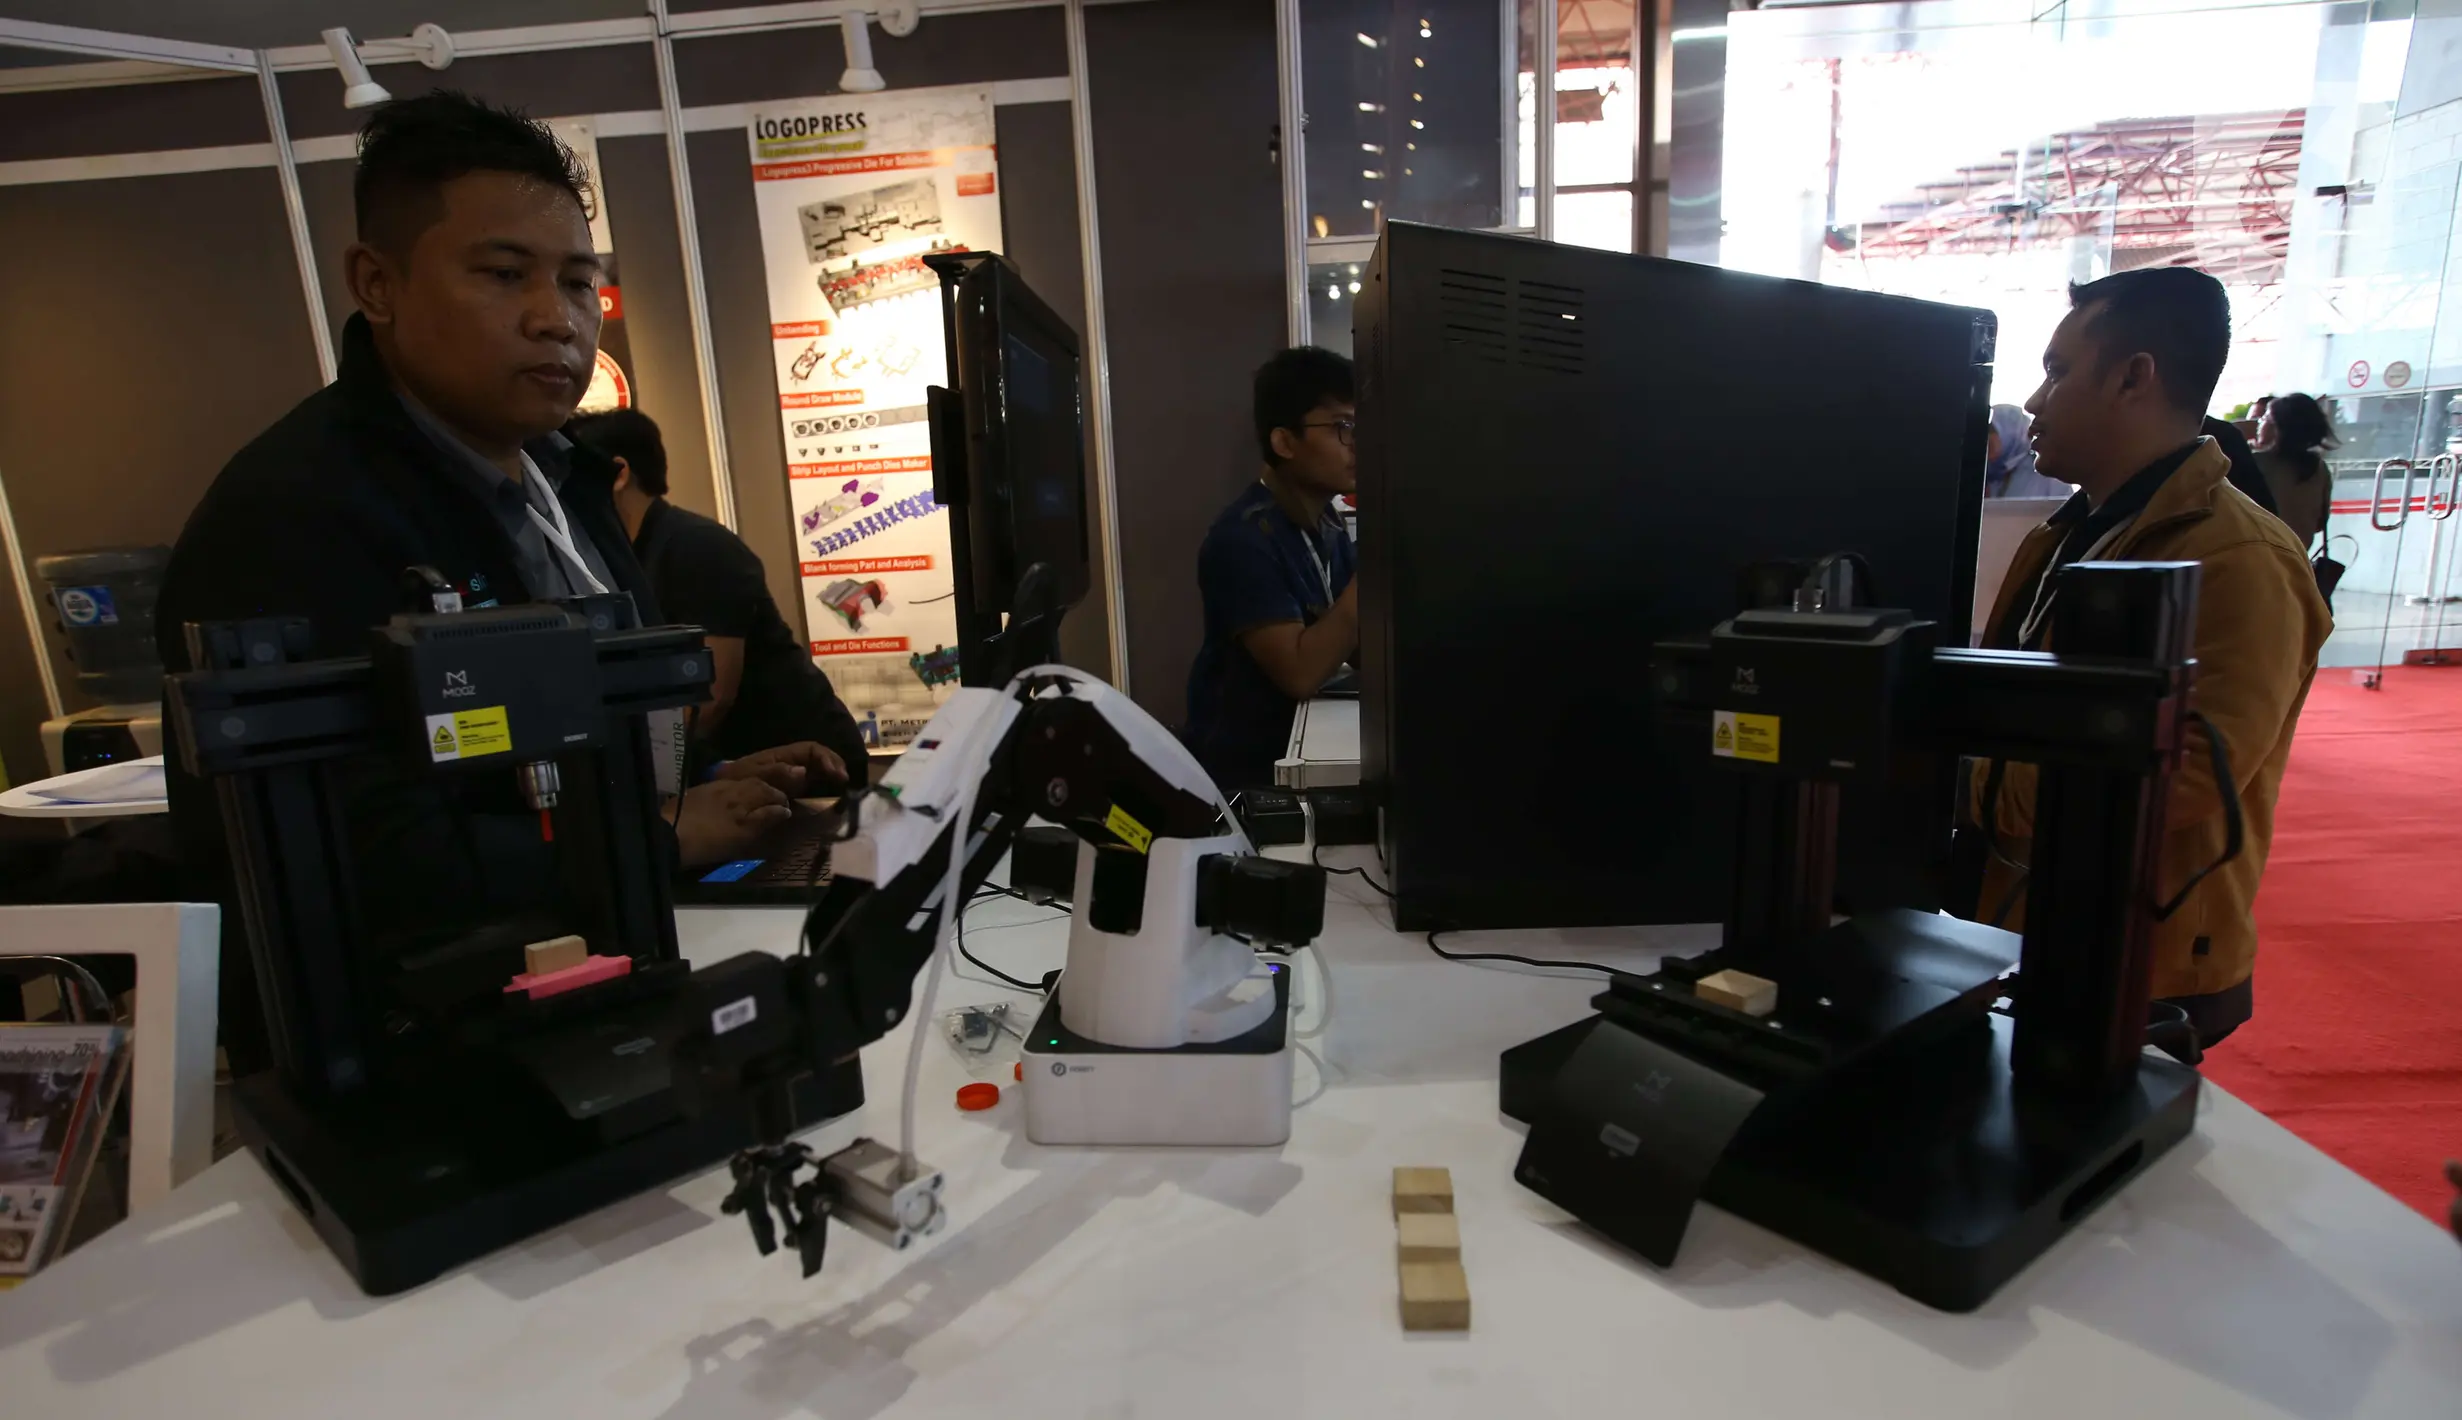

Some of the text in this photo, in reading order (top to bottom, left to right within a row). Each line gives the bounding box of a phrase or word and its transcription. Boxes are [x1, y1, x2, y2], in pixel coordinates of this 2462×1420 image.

[756, 112, 867, 140] LOGOPRESS
[813, 161, 862, 174] Progressive
[791, 466, 812, 476] Strip
[812, 464, 840, 475] Layout
[841, 463, 856, 472] and
[856, 461, 882, 472] Punch
[902, 458, 927, 469] Maker
[804, 558, 926, 573] Blank forming Part and Analysis
[814, 639, 900, 652] Tool and Die Functions
[442, 684, 476, 699] MOOZ
